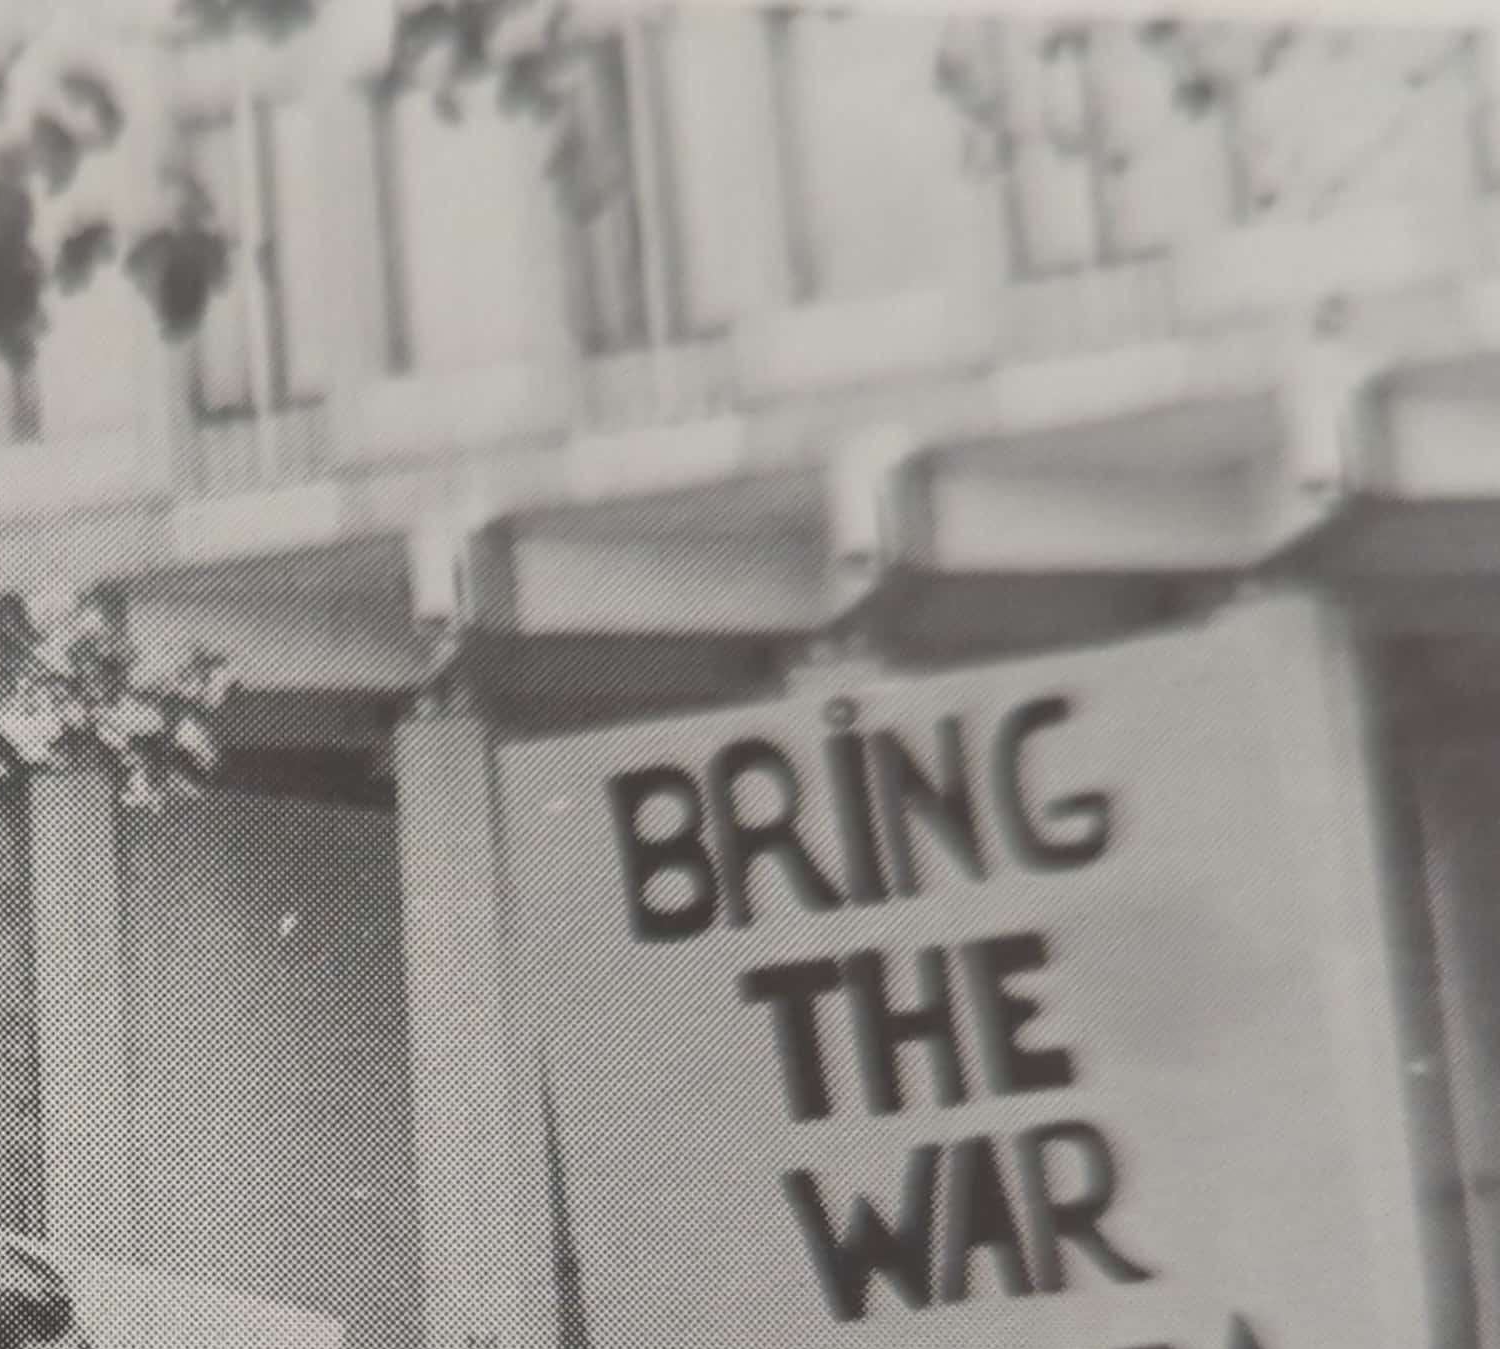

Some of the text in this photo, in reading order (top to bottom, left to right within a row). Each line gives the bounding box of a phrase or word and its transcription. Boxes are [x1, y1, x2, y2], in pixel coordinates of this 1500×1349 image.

[606, 693, 1117, 945] BRING
[737, 931, 1078, 1124] THE
[782, 1118, 1159, 1324] WAR
